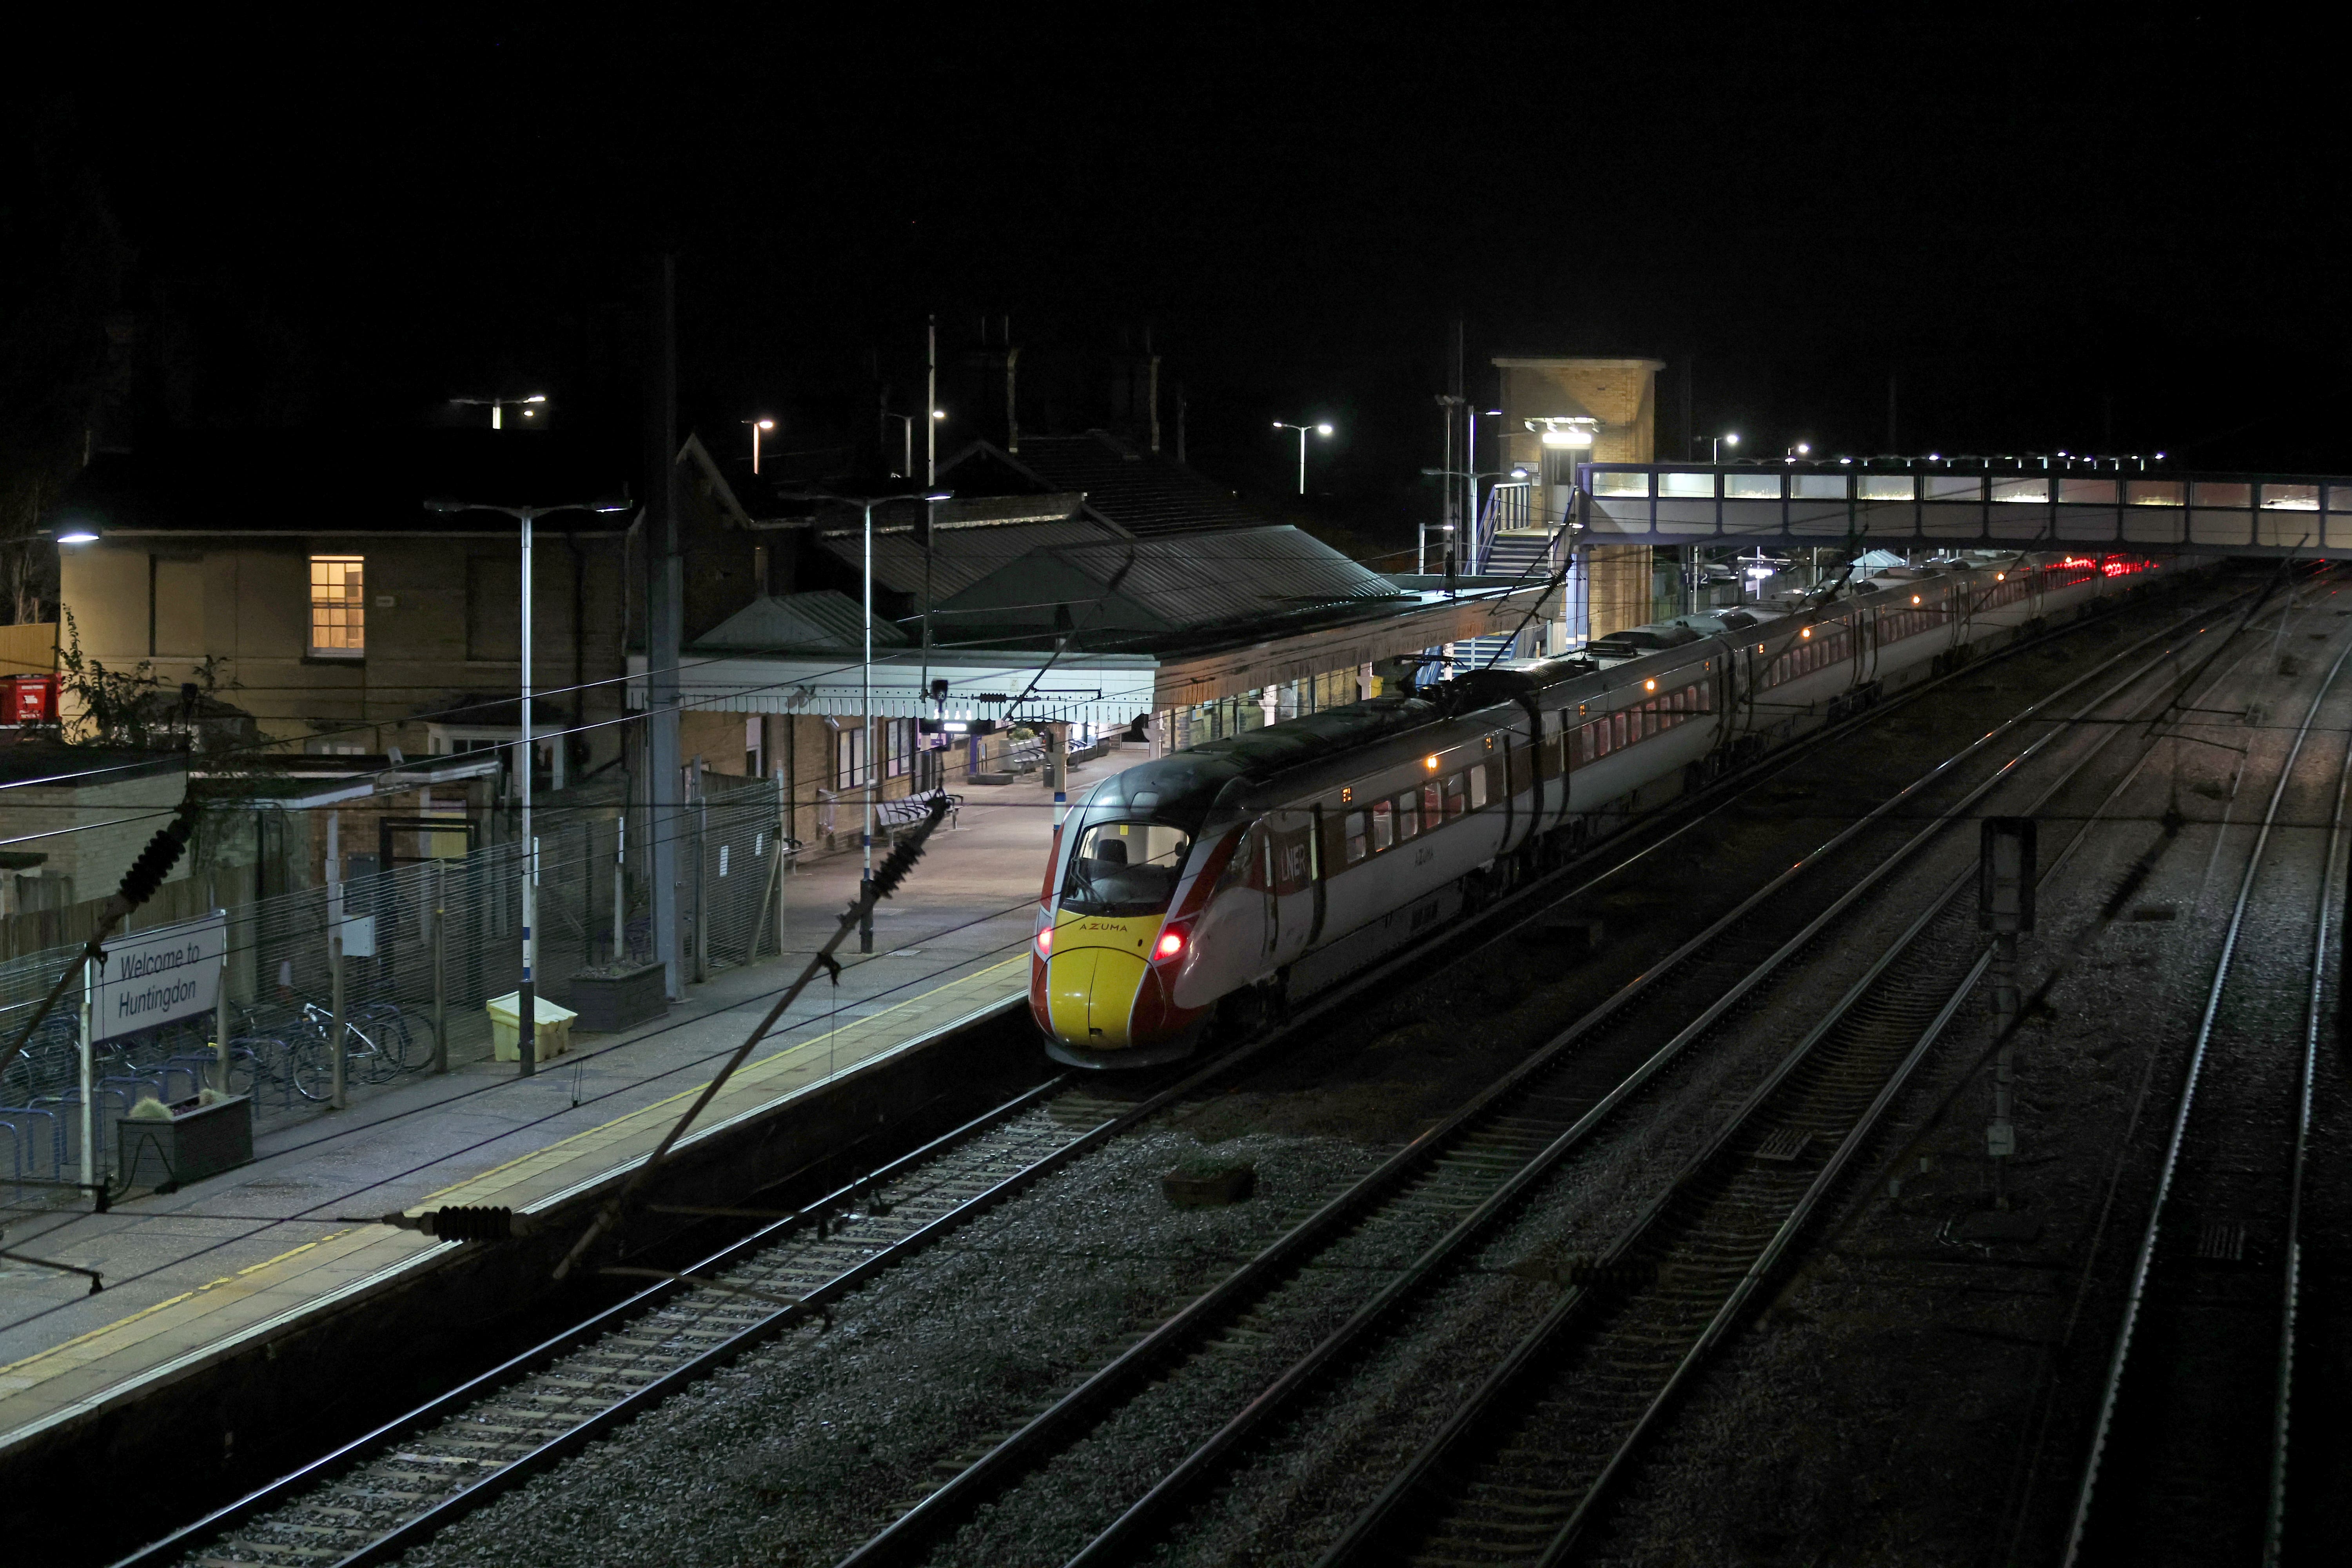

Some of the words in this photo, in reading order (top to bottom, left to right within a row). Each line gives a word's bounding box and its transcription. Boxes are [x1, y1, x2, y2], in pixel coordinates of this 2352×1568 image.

[1685, 573, 1689, 584] 1
[1700, 573, 1708, 584] 2
[1281, 844, 1306, 882] LNER
[121, 949, 183, 981] Welcome
[187, 942, 199, 964] to
[119, 978, 196, 1018] Huntingdon
